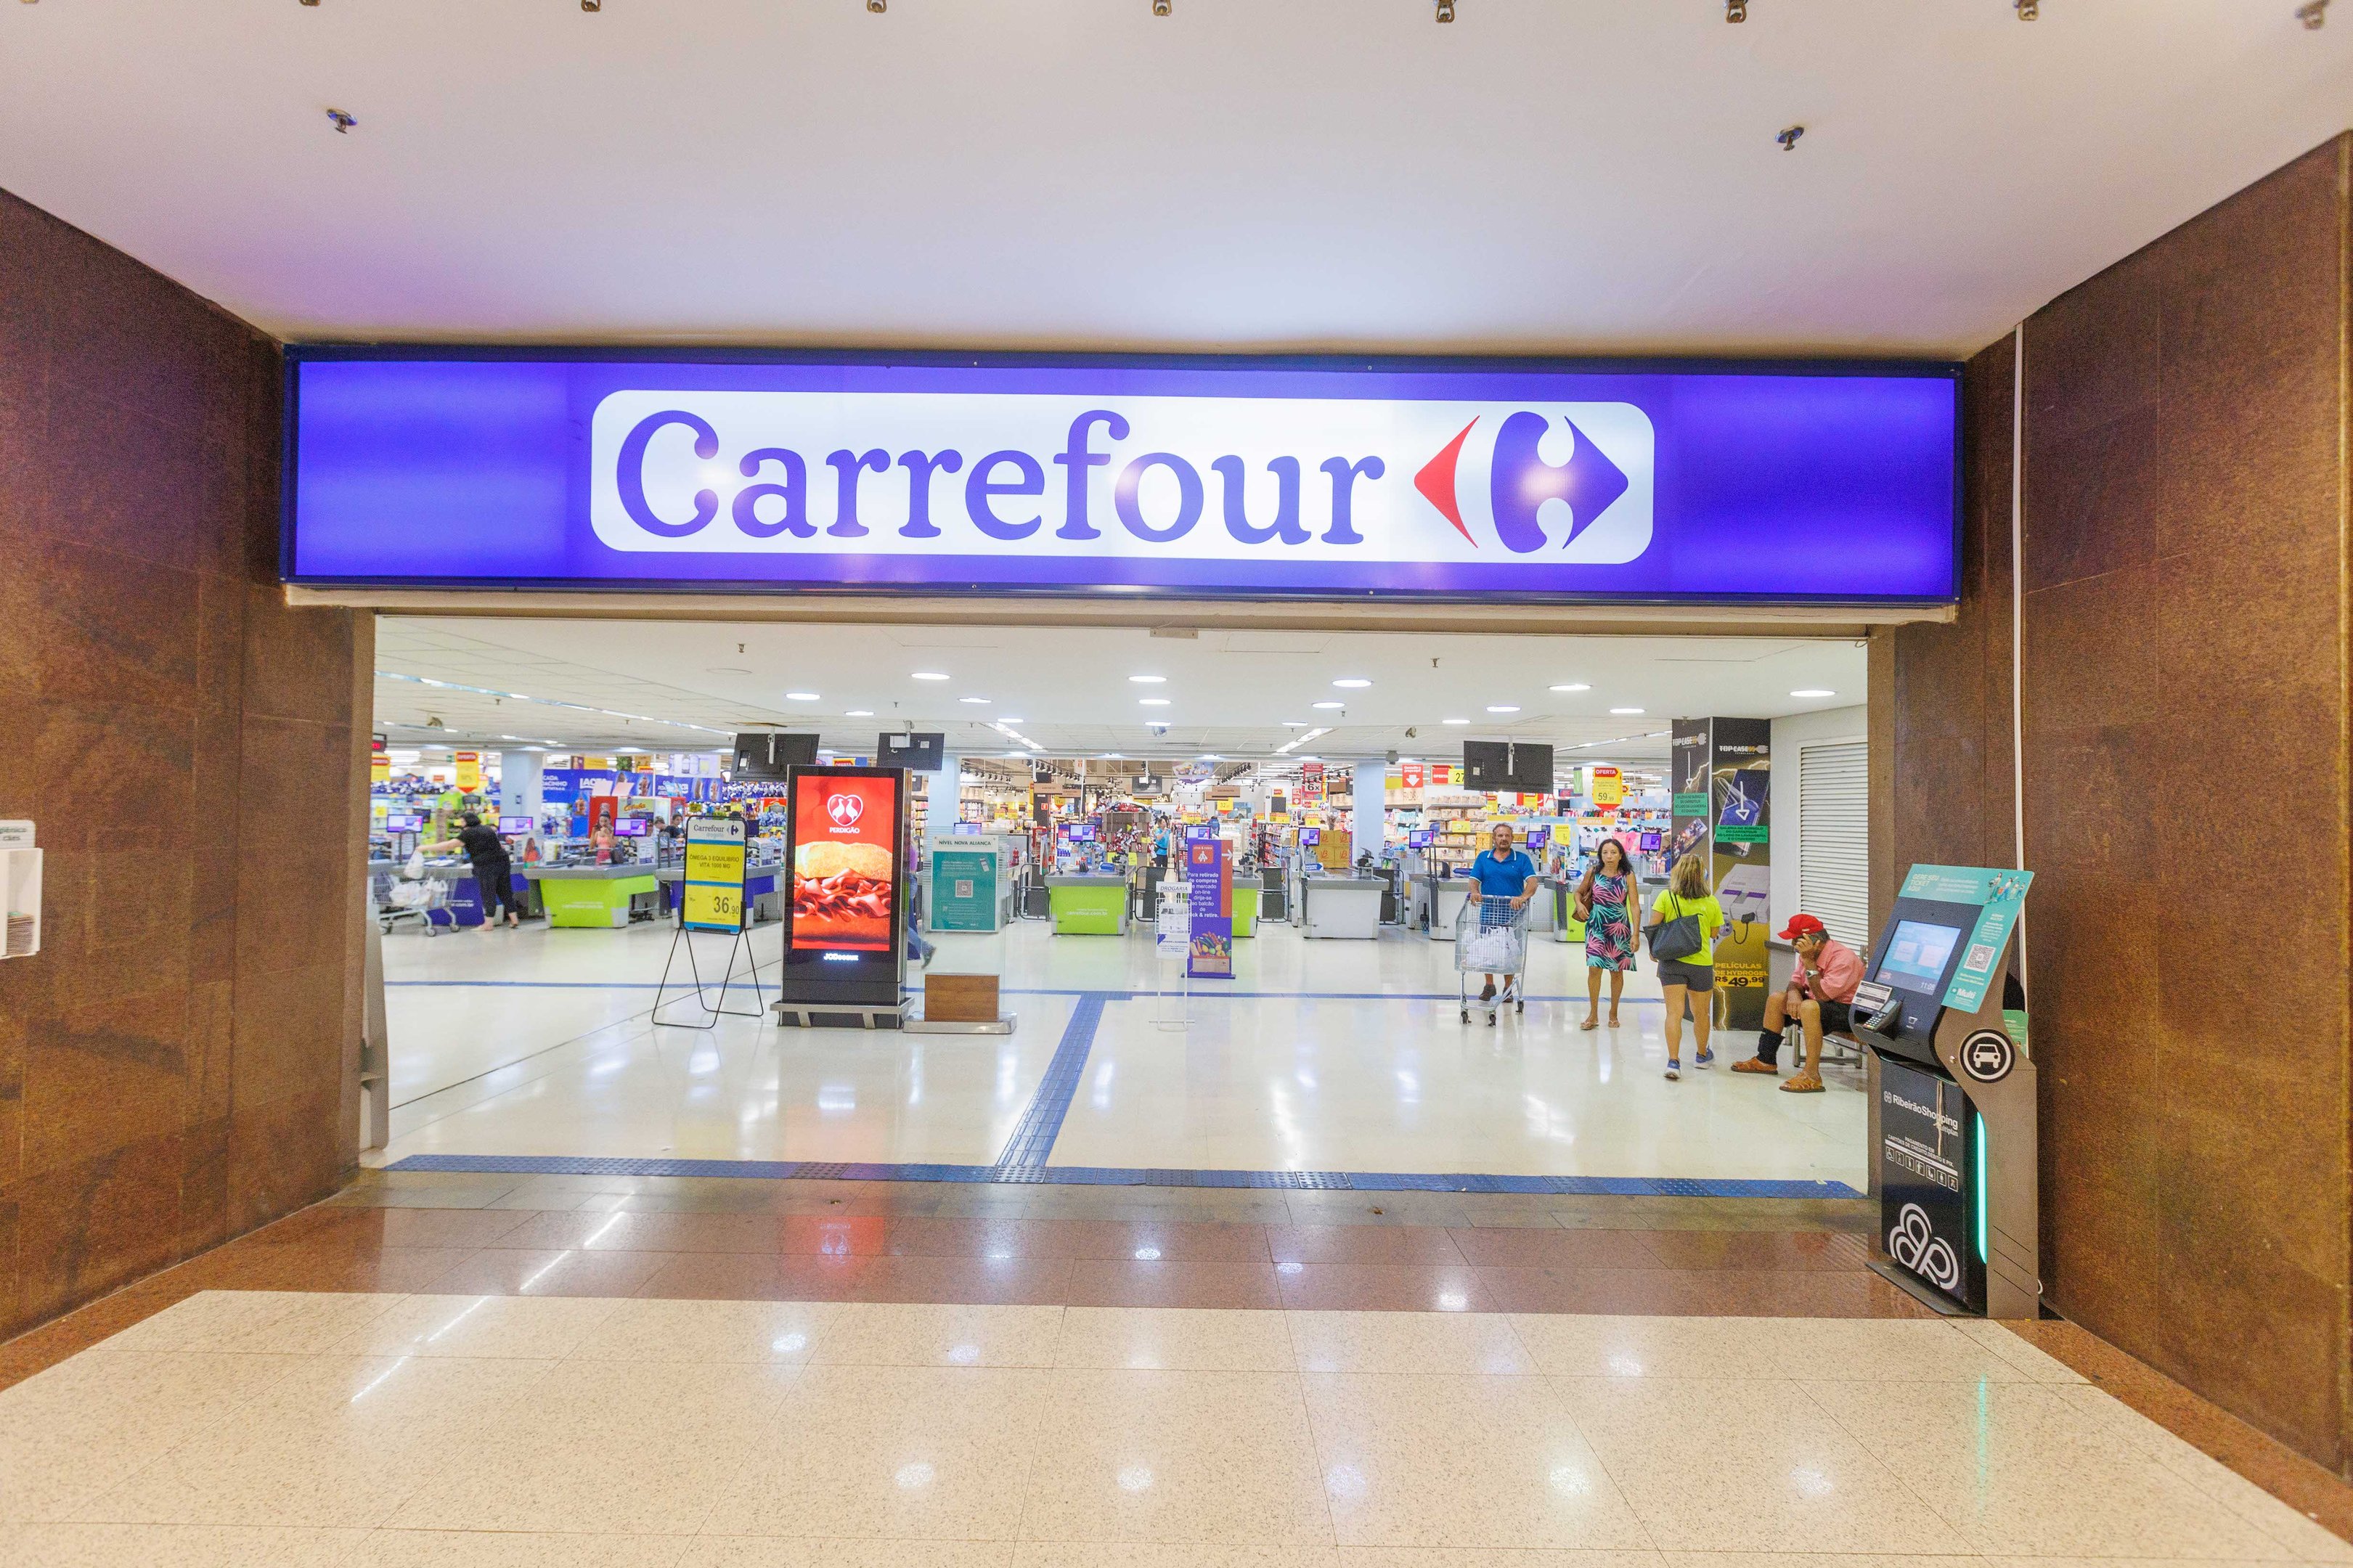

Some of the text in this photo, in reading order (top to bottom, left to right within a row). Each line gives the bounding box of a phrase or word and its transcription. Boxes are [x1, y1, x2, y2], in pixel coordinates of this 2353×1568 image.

[617, 409, 1385, 545] Carrefour
[714, 896, 739, 915] 36,90
[1729, 977, 1764, 987] 49,99
[1957, 988, 1976, 999] Multi
[1893, 1094, 1958, 1130] RibeirãoShoping
[1905, 1136, 1928, 1151] PAGAMENTO
